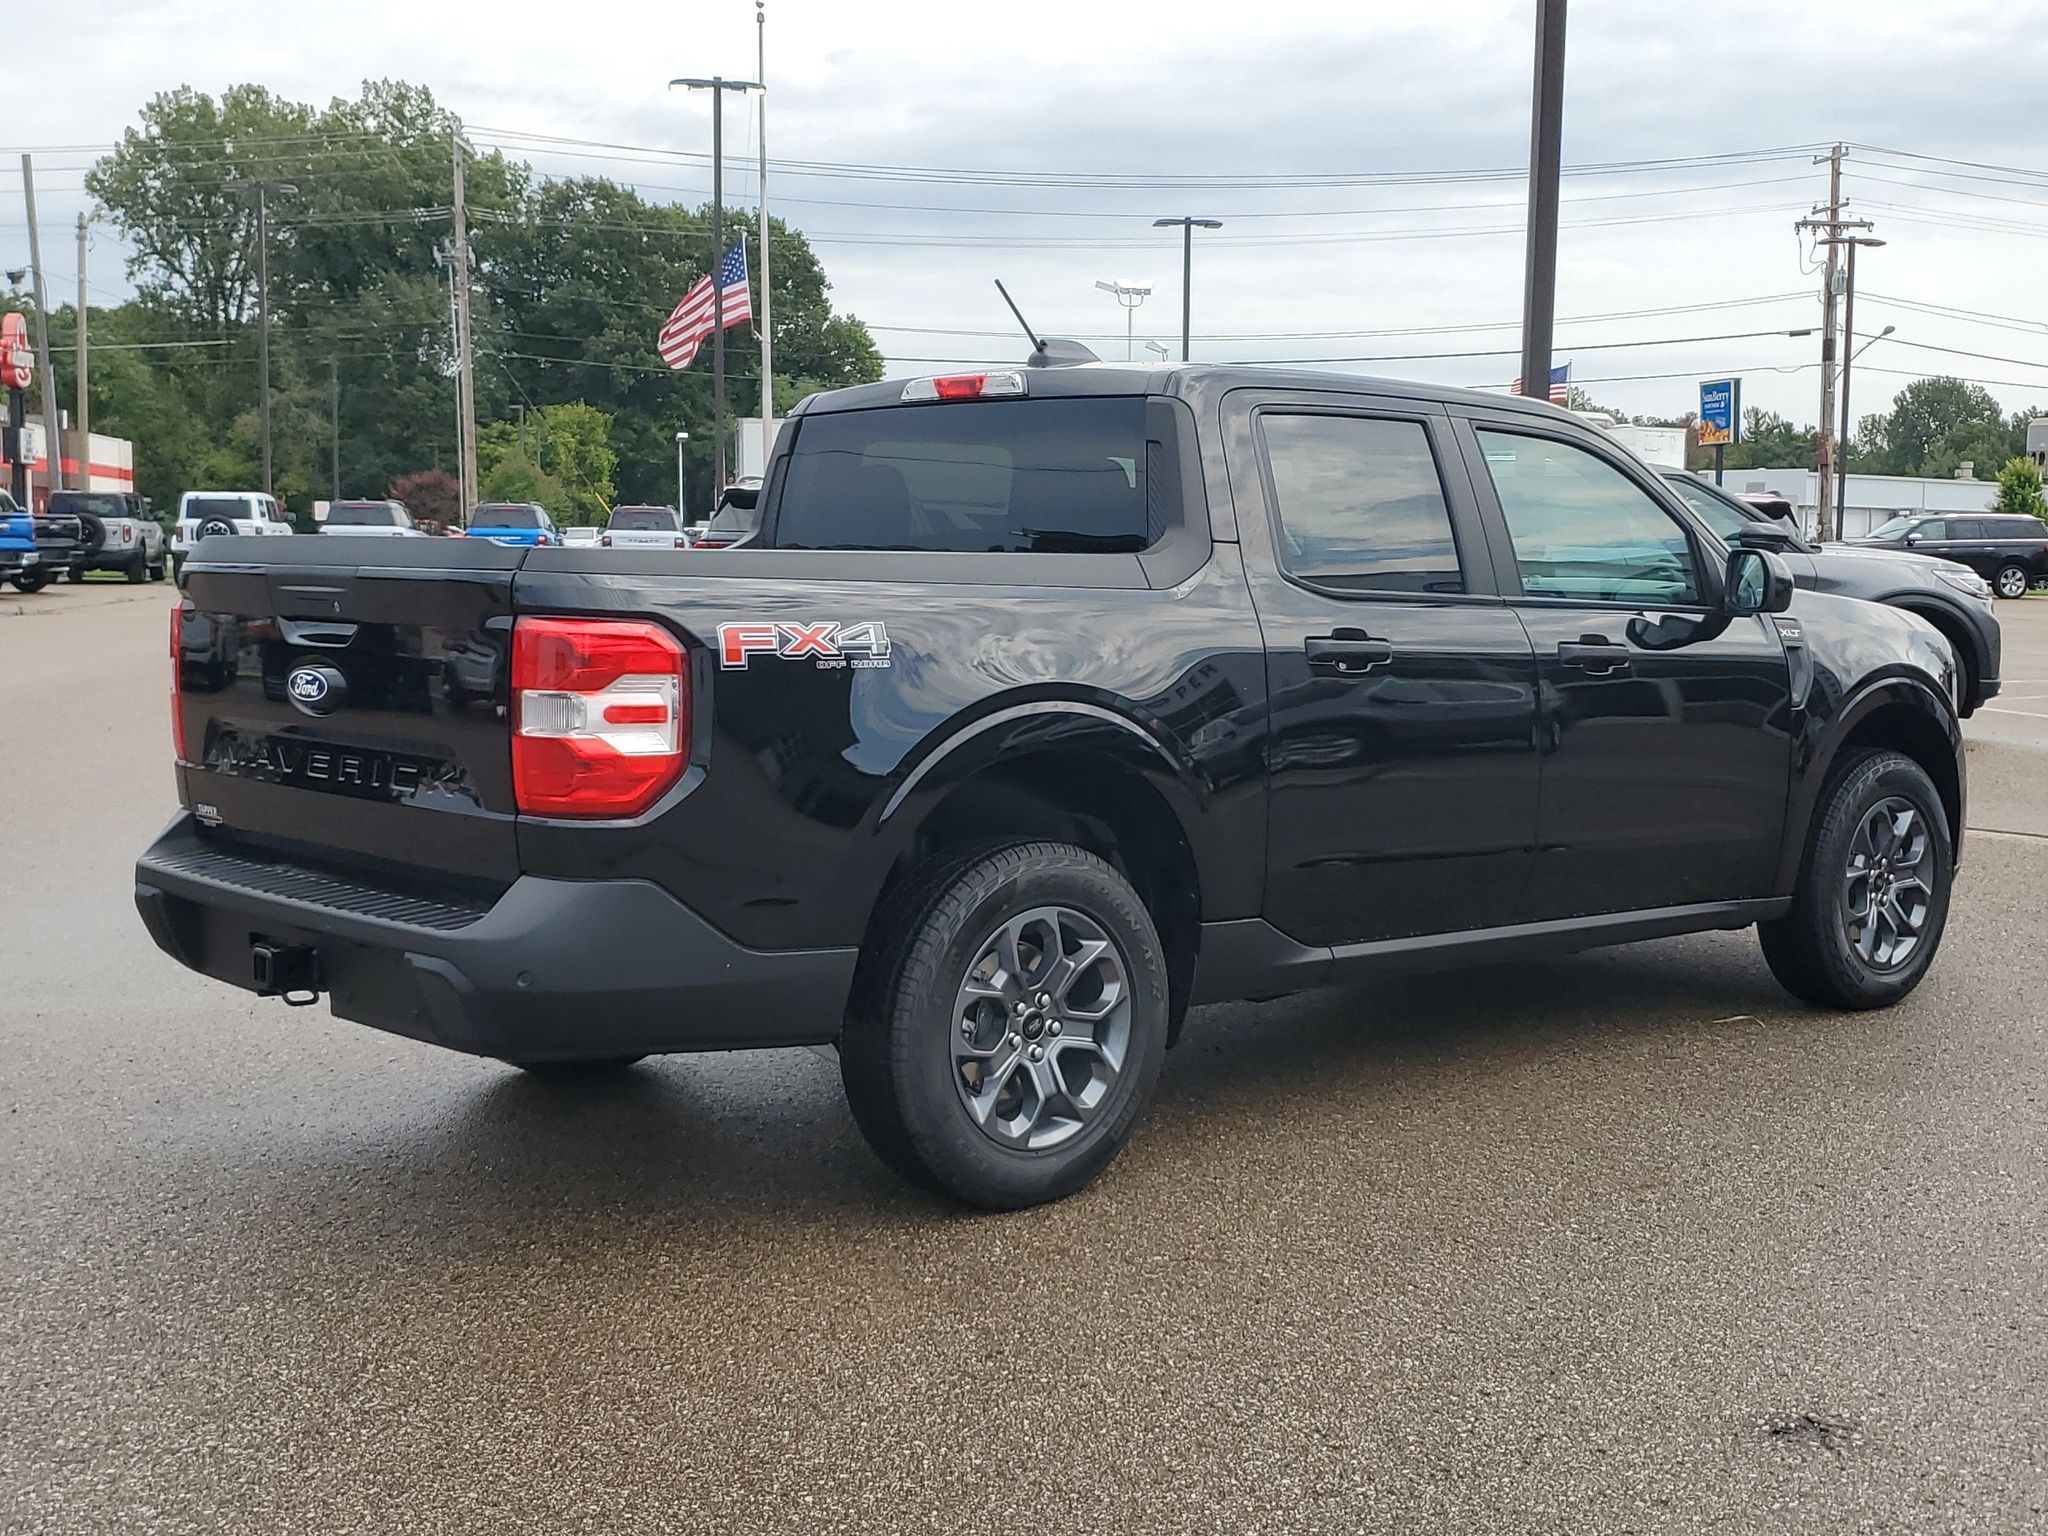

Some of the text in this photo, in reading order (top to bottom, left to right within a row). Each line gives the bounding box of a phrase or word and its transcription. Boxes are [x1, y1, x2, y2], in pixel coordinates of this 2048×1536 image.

[1780, 629, 1801, 637] XLT
[717, 621, 891, 671] FX4
[816, 660, 891, 669] OFF ROAD
[294, 673, 320, 697] Ford
[206, 742, 466, 798] MAVERICK
